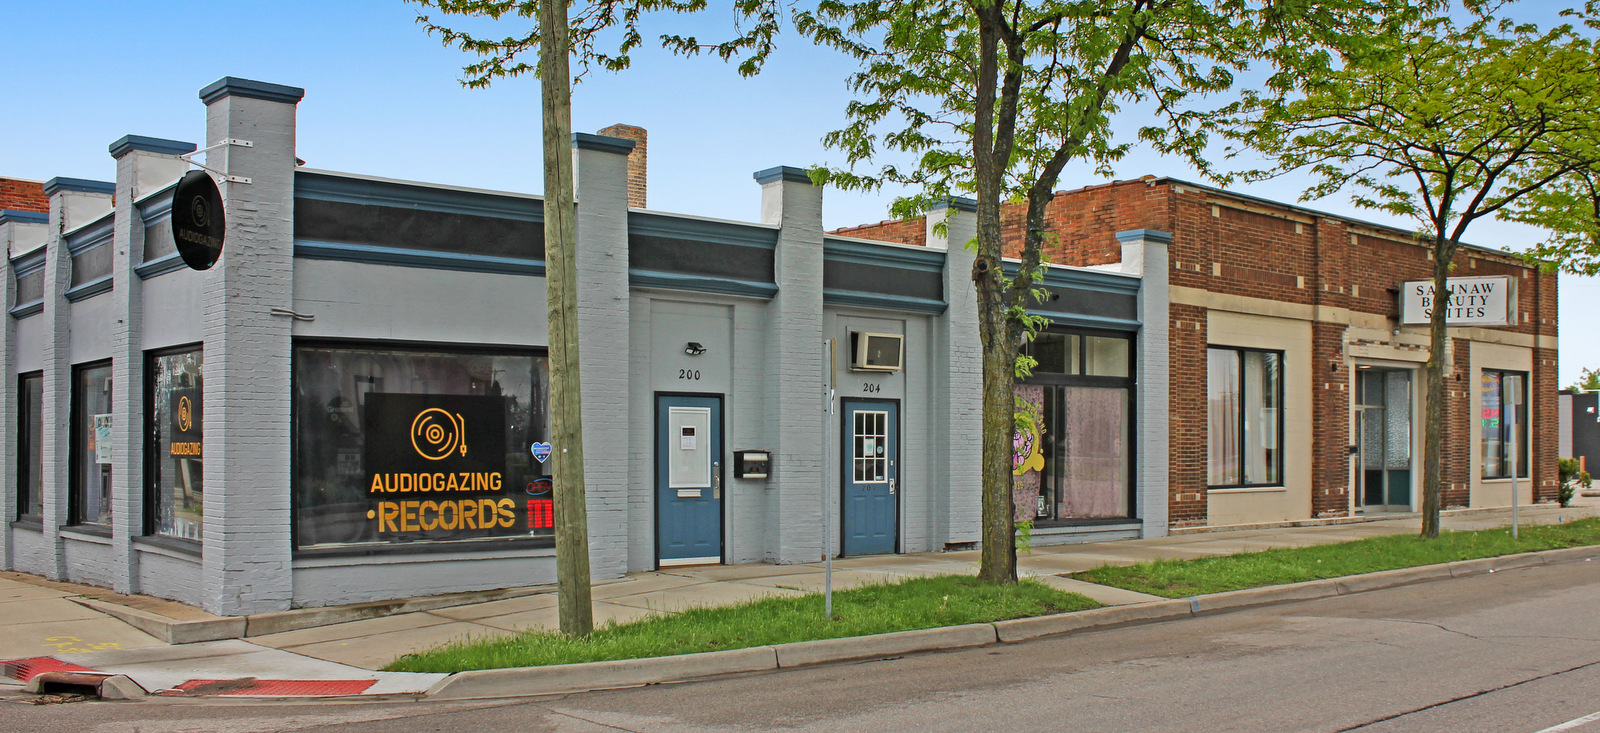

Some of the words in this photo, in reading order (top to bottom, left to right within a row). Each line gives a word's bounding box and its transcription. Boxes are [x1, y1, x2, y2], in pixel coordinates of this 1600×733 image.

[179, 228, 222, 249] AUDIOGAZING
[1416, 283, 1495, 296] SAINAW
[1421, 295, 1489, 307] BAUTY
[1424, 307, 1485, 319] SITES
[679, 369, 701, 380] 200
[863, 382, 881, 394] 204
[170, 442, 200, 455] AUDIOGAZING
[370, 472, 502, 493] AUDIOGAZING
[378, 498, 516, 532] RECORDS
